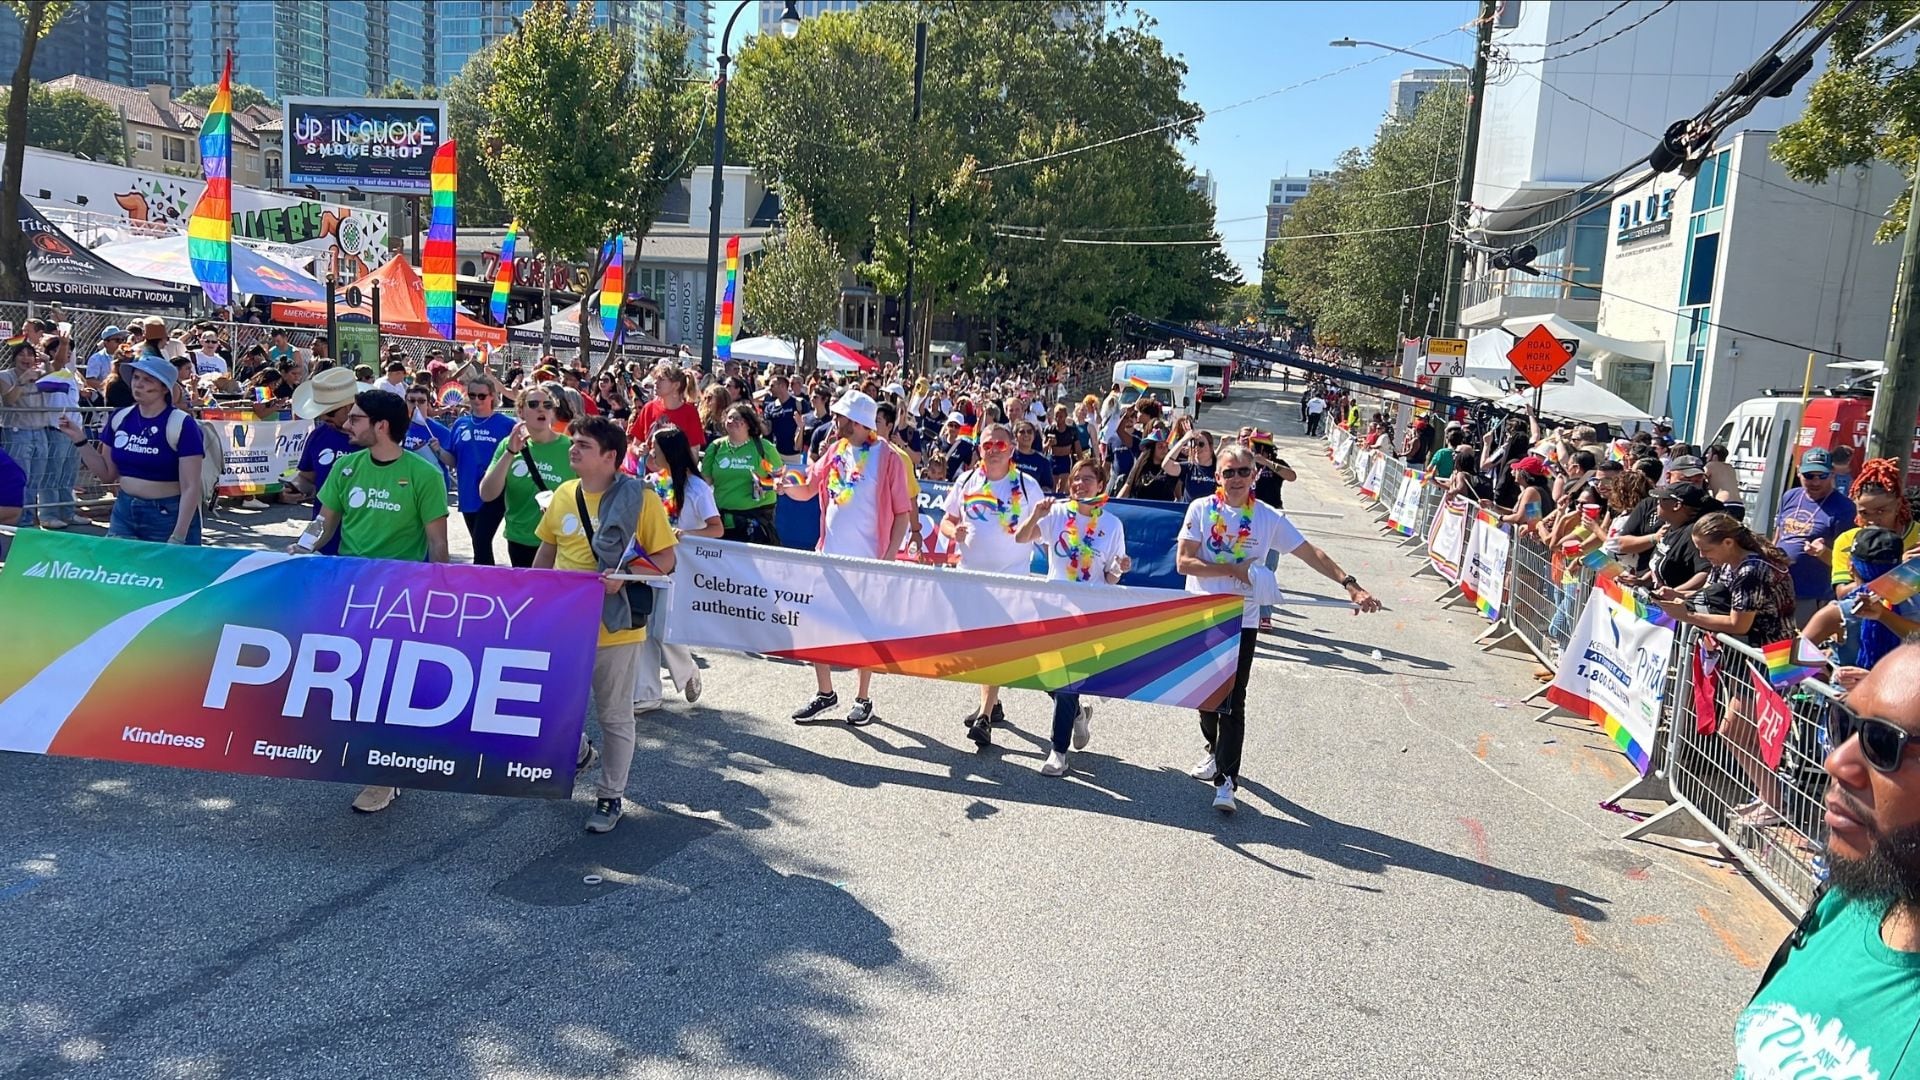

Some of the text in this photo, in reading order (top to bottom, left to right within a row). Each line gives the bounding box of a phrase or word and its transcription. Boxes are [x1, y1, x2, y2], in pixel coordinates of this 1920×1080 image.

[295, 117, 434, 146] UP IN SMOKE
[306, 142, 423, 159] SMOKESHOP
[1618, 188, 1676, 230] BLUE
[64, 283, 111, 297] ORIGINAL
[112, 286, 142, 301] CRAFT
[144, 290, 175, 304] VODKA
[682, 281, 691, 333] CONDOS
[1526, 351, 1550, 361] WORK
[1527, 340, 1551, 349] ROAD
[1522, 363, 1553, 373] AHEAD
[274, 432, 310, 454] Prid
[695, 545, 722, 559] Equal
[50, 560, 164, 590] Manhattan
[693, 573, 814, 605] Celebrate your
[339, 584, 534, 640] HAPPY
[691, 599, 800, 627] authentic self
[202, 623, 552, 738] PRIDE
[122, 726, 552, 781] Kindness Equality Belonging Hope
